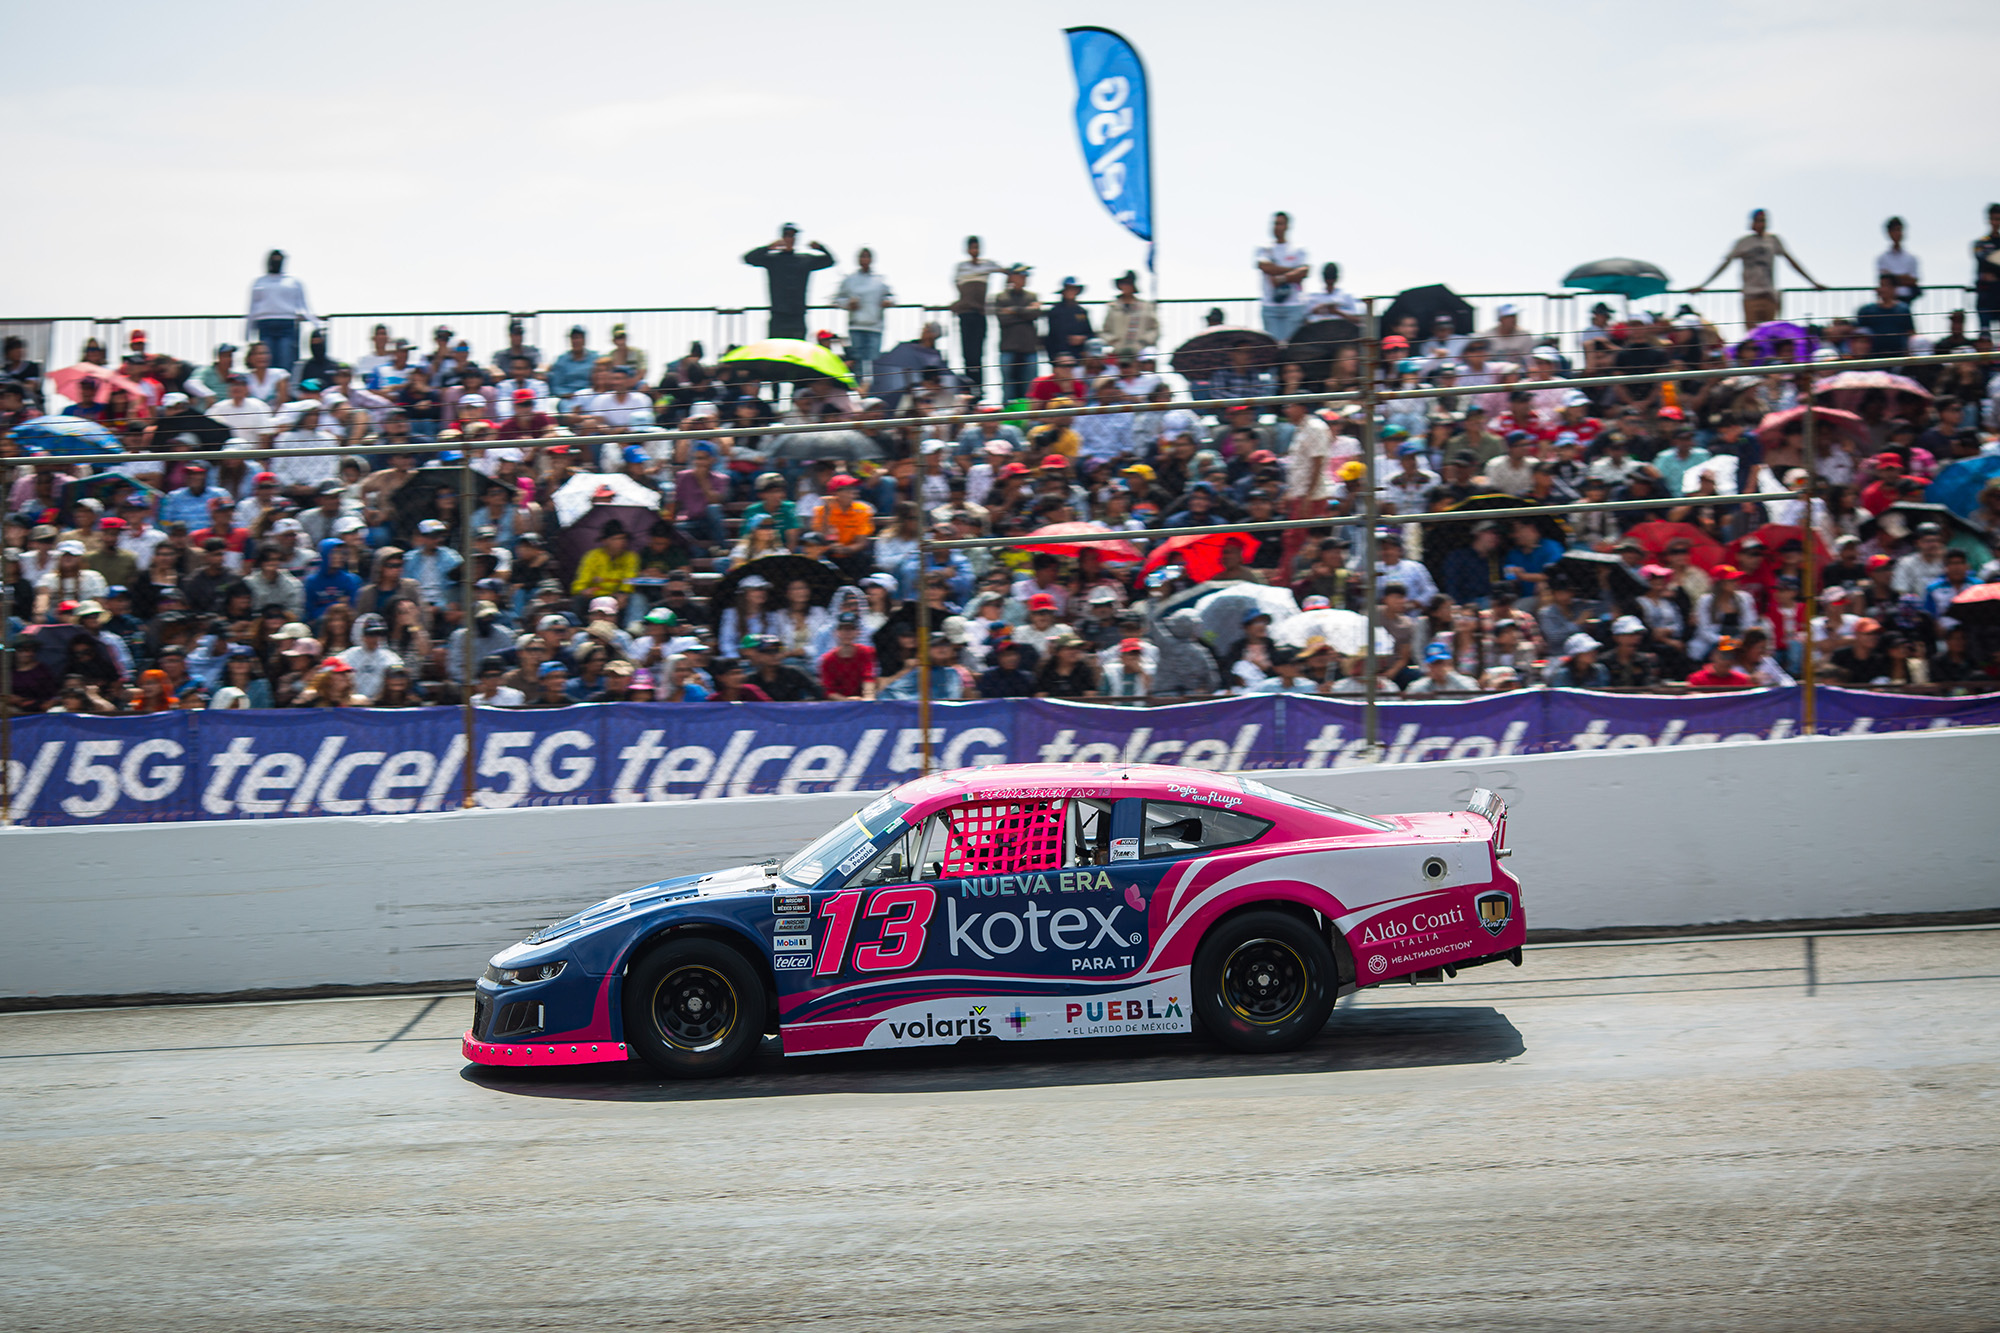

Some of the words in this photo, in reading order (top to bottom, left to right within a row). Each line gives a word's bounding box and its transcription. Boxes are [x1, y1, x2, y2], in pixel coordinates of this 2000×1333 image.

[60, 738, 187, 818] 5G
[201, 733, 469, 815] telcel
[474, 730, 596, 808] 5G
[611, 729, 887, 804] telcel
[980, 788, 1022, 799] REGINA
[1022, 787, 1071, 798] SIRVENT
[1166, 783, 1198, 797] Deja
[1192, 793, 1208, 802] que
[1208, 791, 1243, 808] fluya
[961, 874, 1052, 898] NUEVA
[1059, 870, 1114, 892] ERA
[812, 884, 937, 977] 13
[1362, 920, 1408, 944] Aldo
[1411, 904, 1464, 932] Conti
[776, 939, 798, 947] Mobil
[1391, 940, 1471, 964] HEALTHADDICTION
[1393, 932, 1439, 949] ITALIA
[776, 955, 811, 968] telcel
[1072, 958, 1116, 971] PARA
[1120, 956, 1136, 968] TI
[1066, 996, 1183, 1023] PUEBLA
[889, 1006, 992, 1039] volaris
[1073, 1027, 1085, 1035] EL
[1088, 1025, 1121, 1034] LATIDO
[1125, 1024, 1137, 1032] DE
[1141, 1022, 1178, 1032] MÉXICO
